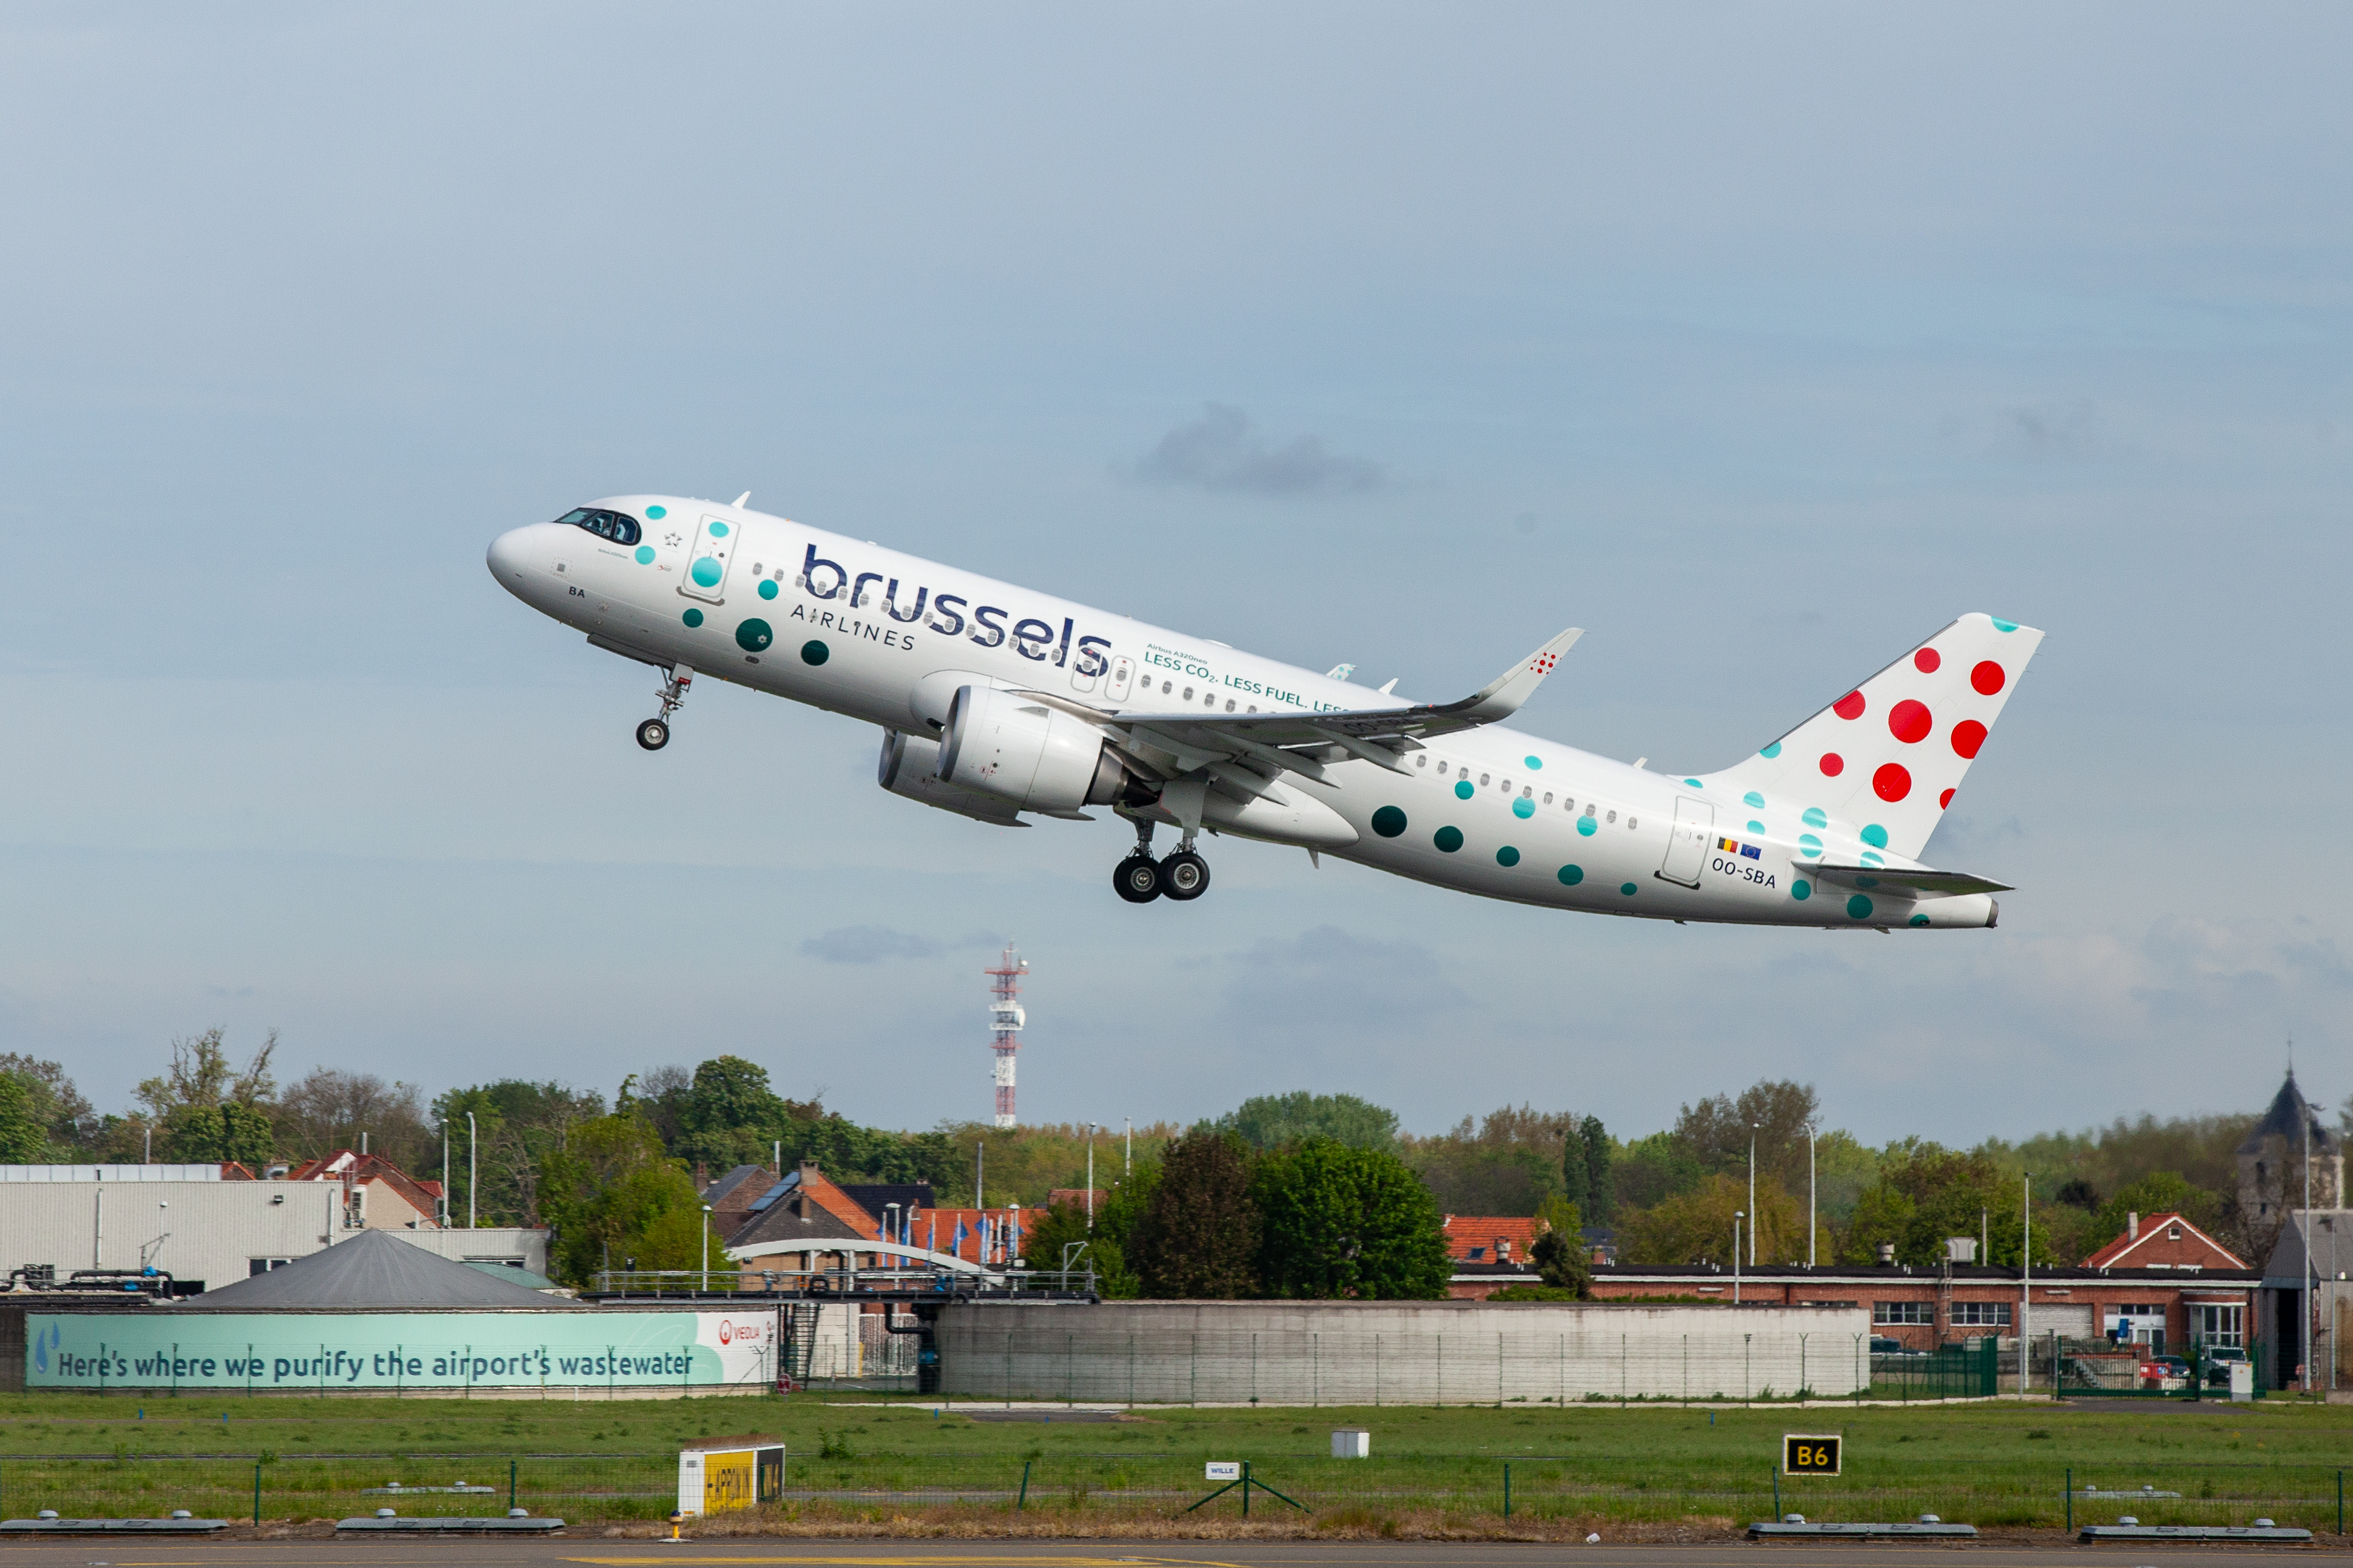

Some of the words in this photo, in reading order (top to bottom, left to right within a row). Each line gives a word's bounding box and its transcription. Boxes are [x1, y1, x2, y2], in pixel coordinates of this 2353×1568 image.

[569, 586, 585, 598] BA
[803, 543, 1112, 677] brussels
[790, 604, 915, 651] AIRLINES
[1147, 643, 1172, 655] Airbus
[1173, 651, 1208, 664] A320neo
[1145, 651, 1182, 671] LESS
[1224, 675, 1262, 694] LESS
[1266, 687, 1307, 708] FUEL.
[1712, 858, 1775, 888] OO-SBA
[58, 1350, 128, 1377] Here's
[135, 1351, 216, 1377] where
[225, 1358, 265, 1377] we
[274, 1351, 364, 1383] purify
[374, 1351, 423, 1376] the
[432, 1350, 551, 1381] airport's
[559, 1351, 693, 1375] wastewater
[1797, 1446, 1828, 1466] B6
